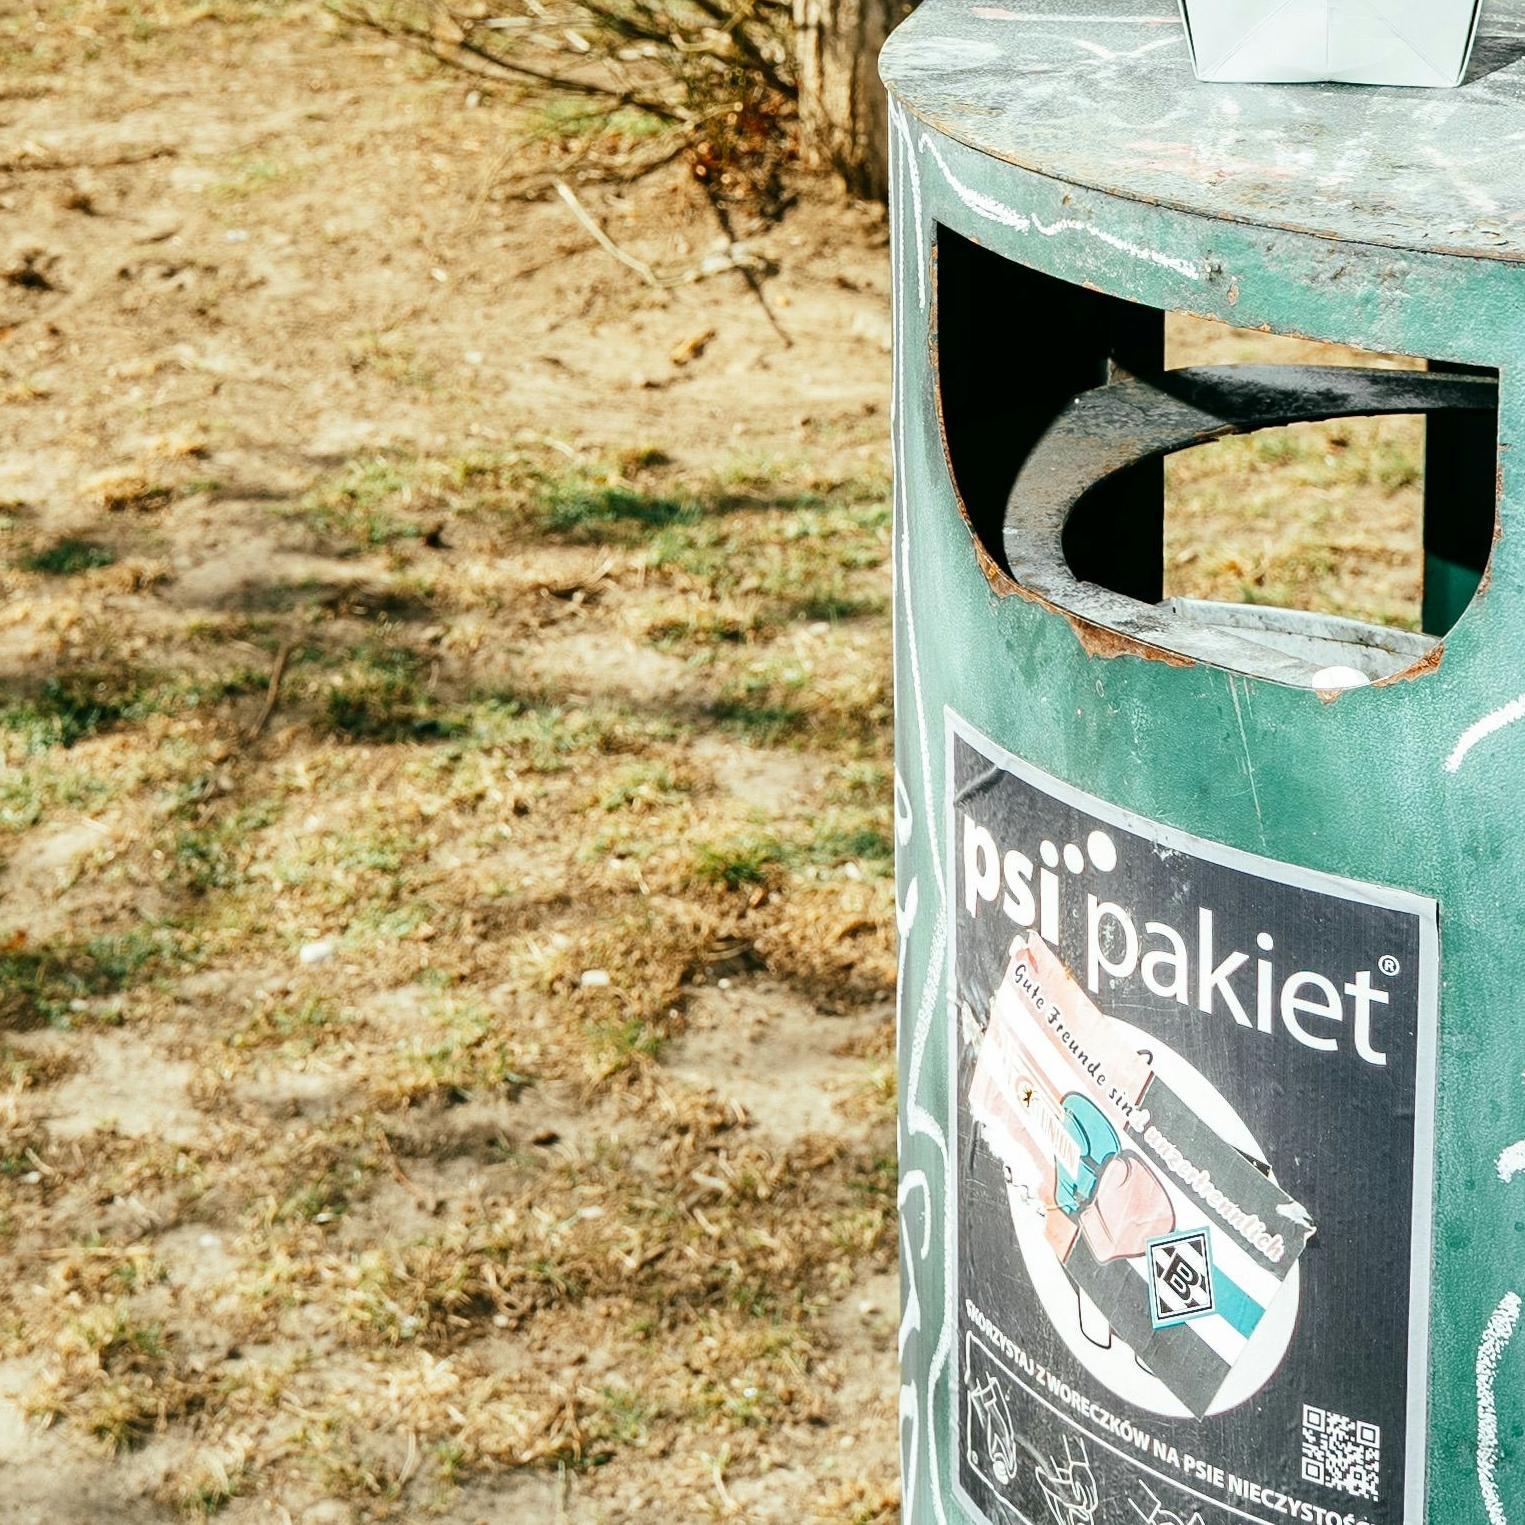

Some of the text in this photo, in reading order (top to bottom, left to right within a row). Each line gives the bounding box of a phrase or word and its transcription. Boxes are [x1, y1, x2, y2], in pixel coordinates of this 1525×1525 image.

[1014, 963, 1045, 1010] Gute
[1047, 1005, 1107, 1086] Freunde
[965, 1298, 1035, 1376] SKORZYSTAJ
[1035, 1363, 1047, 1386] Z
[1046, 1371, 1151, 1452] WORECZKÓW
[1152, 1441, 1180, 1468] NA
[1183, 1453, 1226, 1489] PSIE
